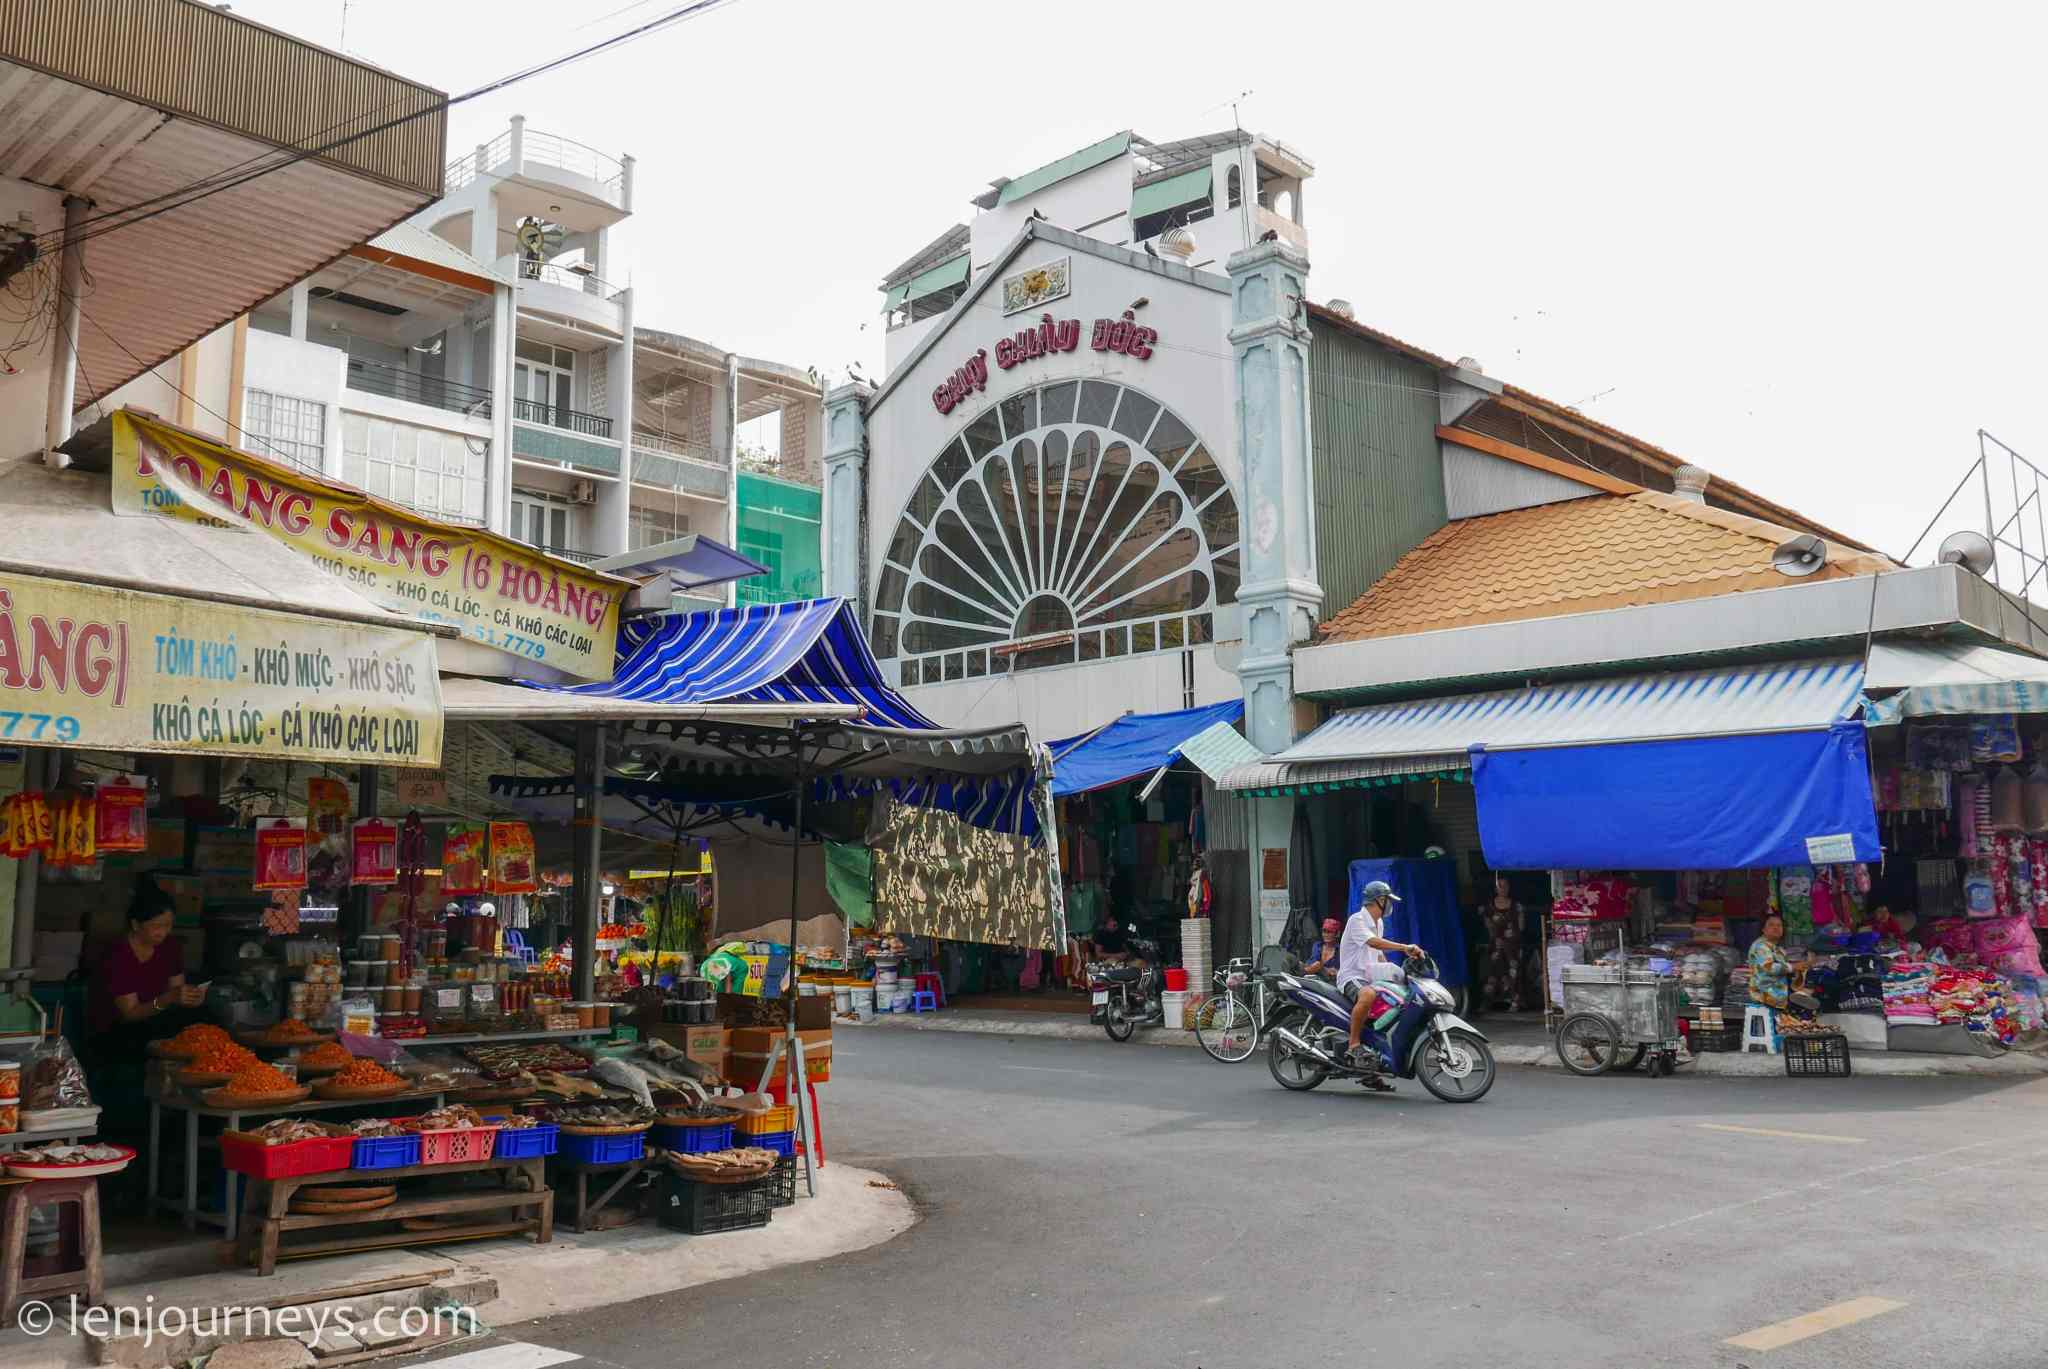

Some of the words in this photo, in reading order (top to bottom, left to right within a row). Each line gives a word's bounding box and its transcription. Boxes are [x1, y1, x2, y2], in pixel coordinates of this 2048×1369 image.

[324, 506, 450, 579] SANG
[396, 579, 427, 602] KHÔ
[431, 588, 450, 610] CÁ
[454, 595, 481, 618] LÓC
[494, 608, 511, 627] CÁ
[516, 617, 543, 636] KHÔ
[545, 624, 569, 645] CÁC
[569, 633, 593, 656] LOẠI
[154, 626, 195, 677] TÔM
[198, 632, 237, 682] KHÔ
[254, 640, 290, 687] KHÔ
[295, 648, 333, 694] MỰC
[152, 695, 192, 742] KHÔ
[198, 698, 223, 743] CÁ
[228, 700, 264, 745] LÓC
[281, 702, 301, 747] CÁ
[308, 704, 343, 749] KHÔ
[348, 707, 379, 752] CÁC
[384, 718, 419, 763] LOẠI
